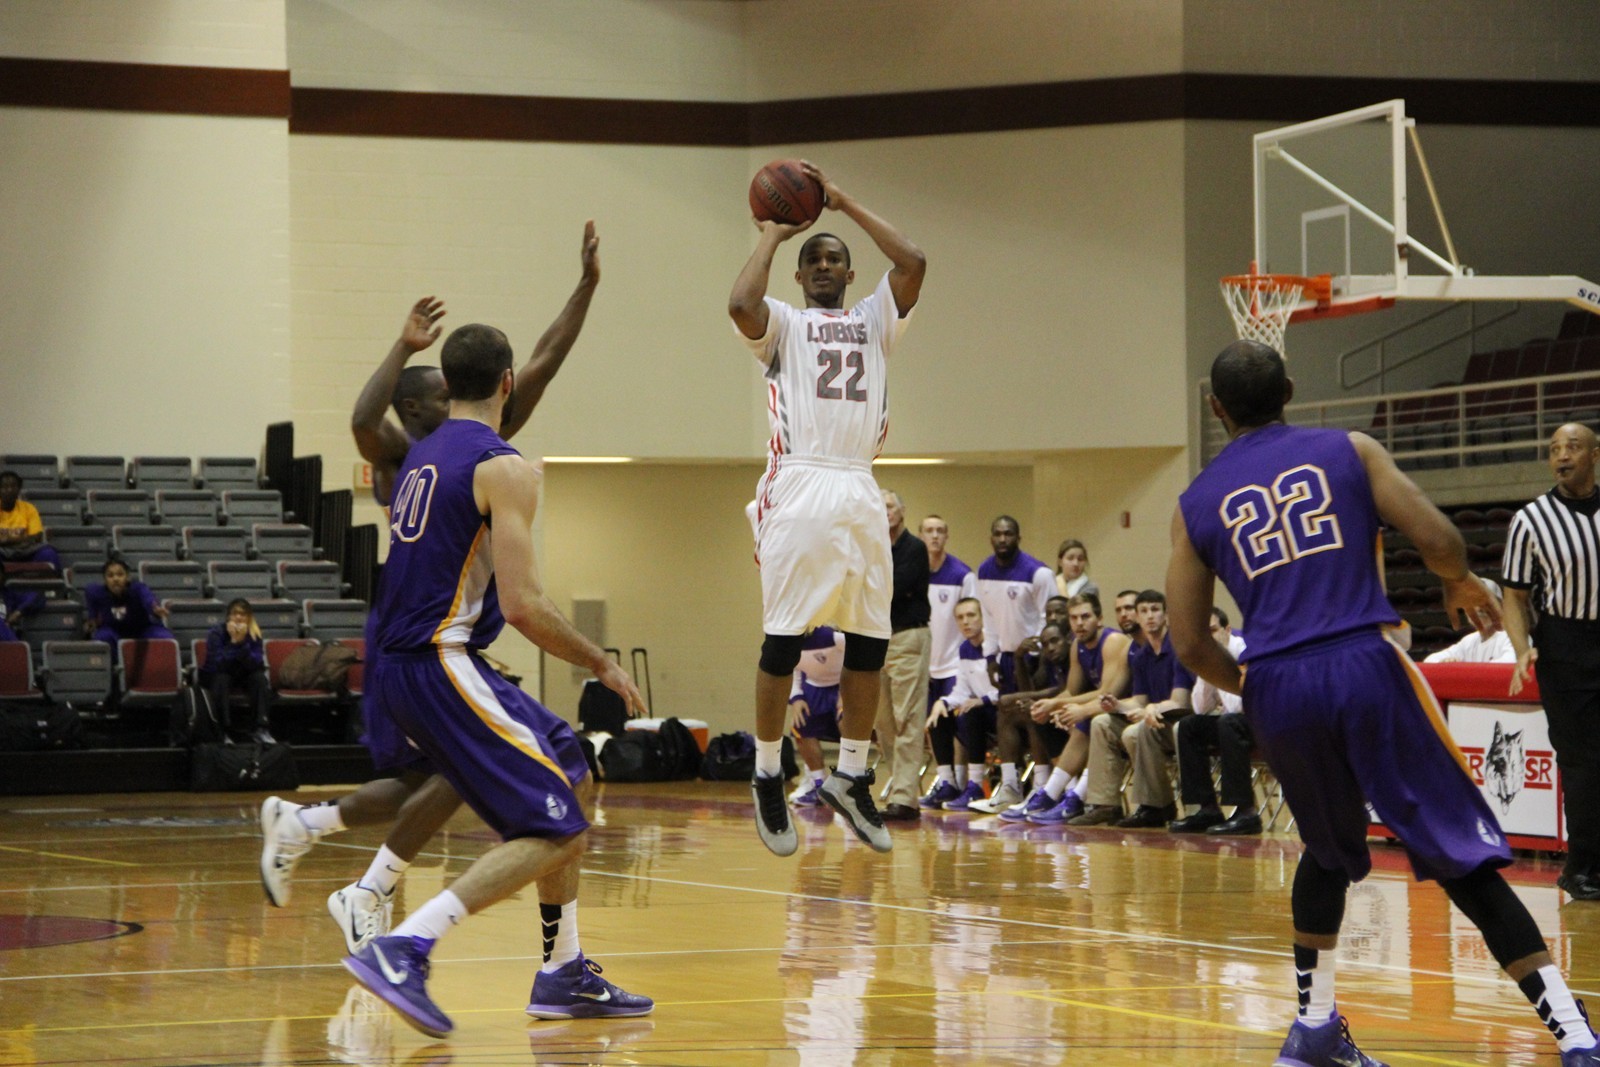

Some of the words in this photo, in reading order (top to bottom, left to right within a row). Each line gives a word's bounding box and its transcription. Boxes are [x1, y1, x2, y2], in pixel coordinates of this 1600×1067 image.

[758, 174, 793, 217] Wilson
[1577, 288, 1600, 304] SC
[807, 322, 868, 345] LOBOS
[816, 349, 867, 402] 22
[1218, 463, 1344, 581] 22
[1525, 757, 1553, 782] SR
